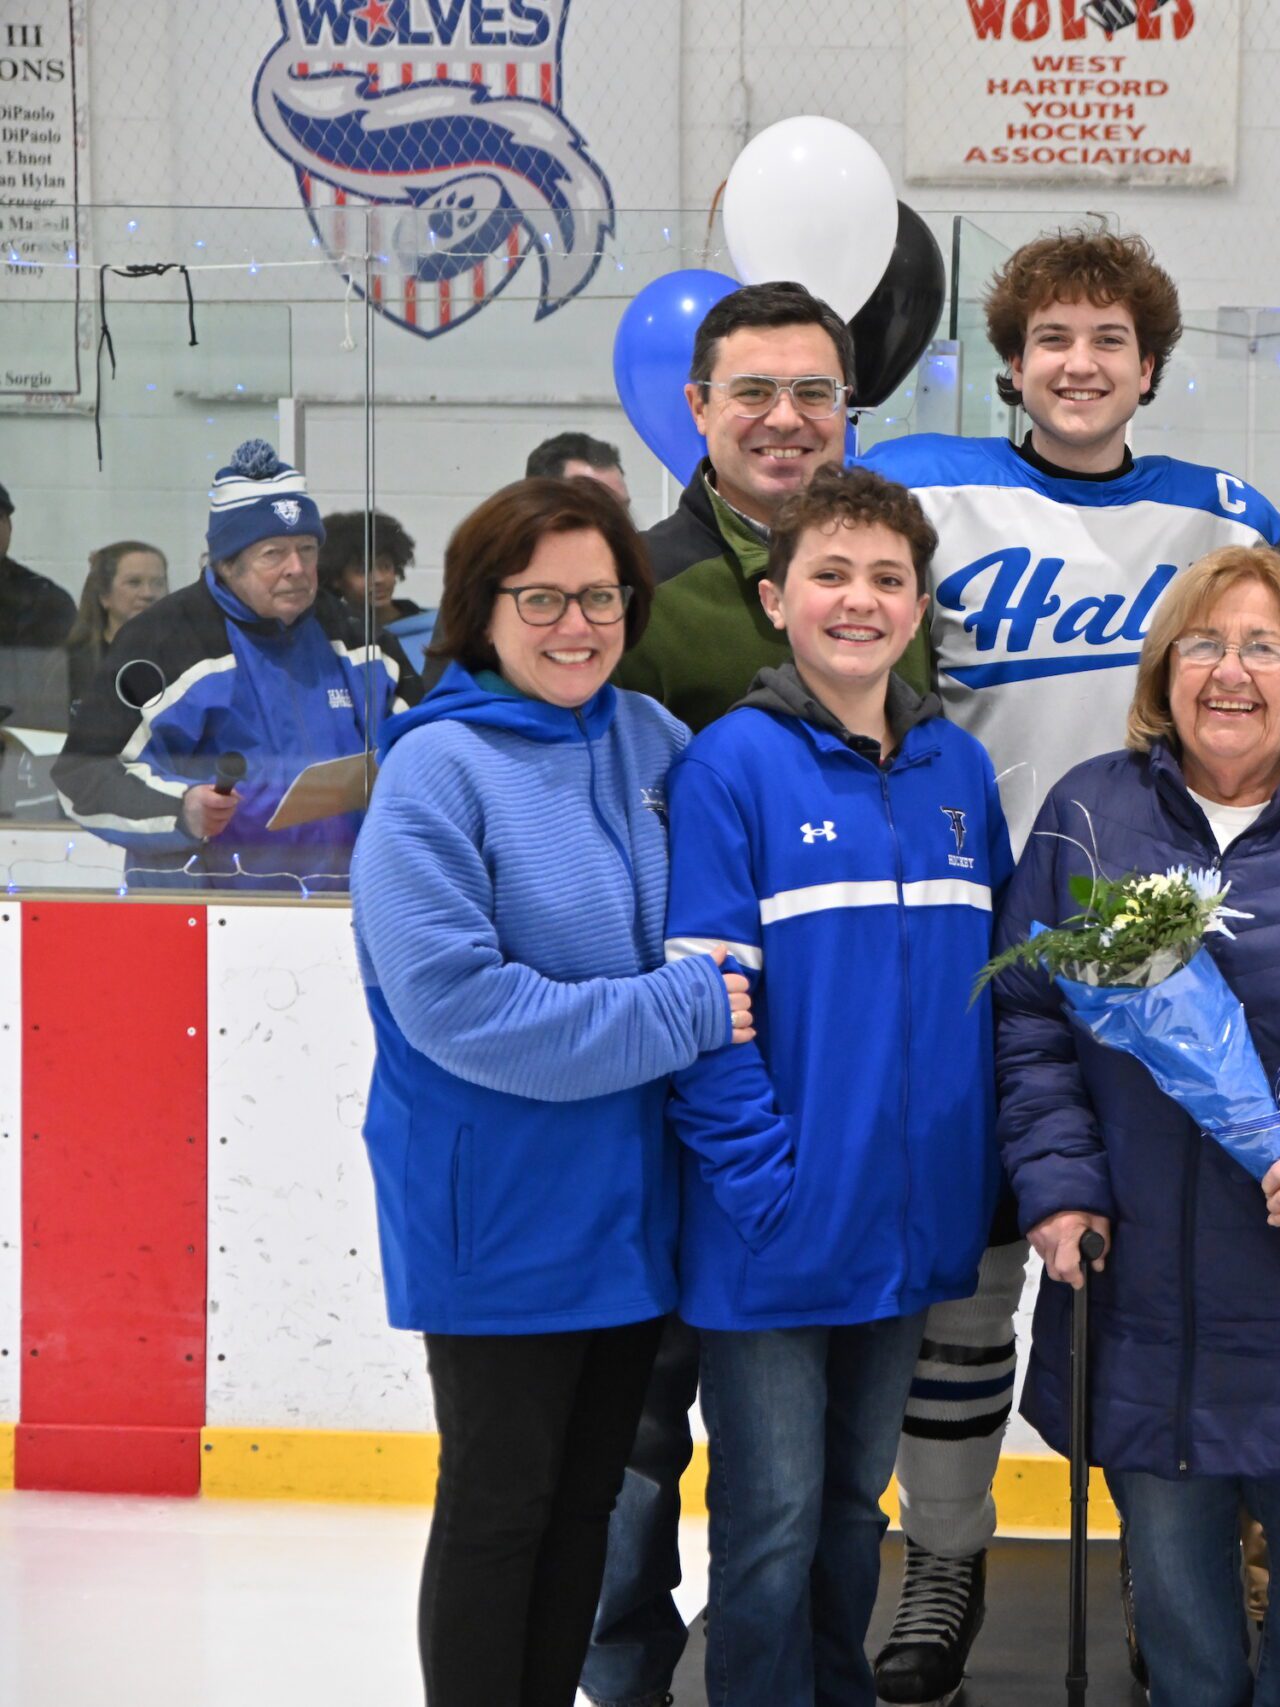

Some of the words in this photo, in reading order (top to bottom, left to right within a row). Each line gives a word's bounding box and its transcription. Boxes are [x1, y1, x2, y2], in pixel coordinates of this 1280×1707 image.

[6, 24, 43, 48] III
[1033, 56, 1126, 73] WEST
[986, 79, 1169, 97] HARTFORD
[1024, 102, 1135, 119] YOUTH
[3, 127, 61, 143] DiPaolo
[1006, 124, 1147, 141] HOCKEY
[963, 147, 1192, 165] ASSOCIATION
[1215, 472, 1247, 515] C
[936, 546, 1180, 652] Hal
